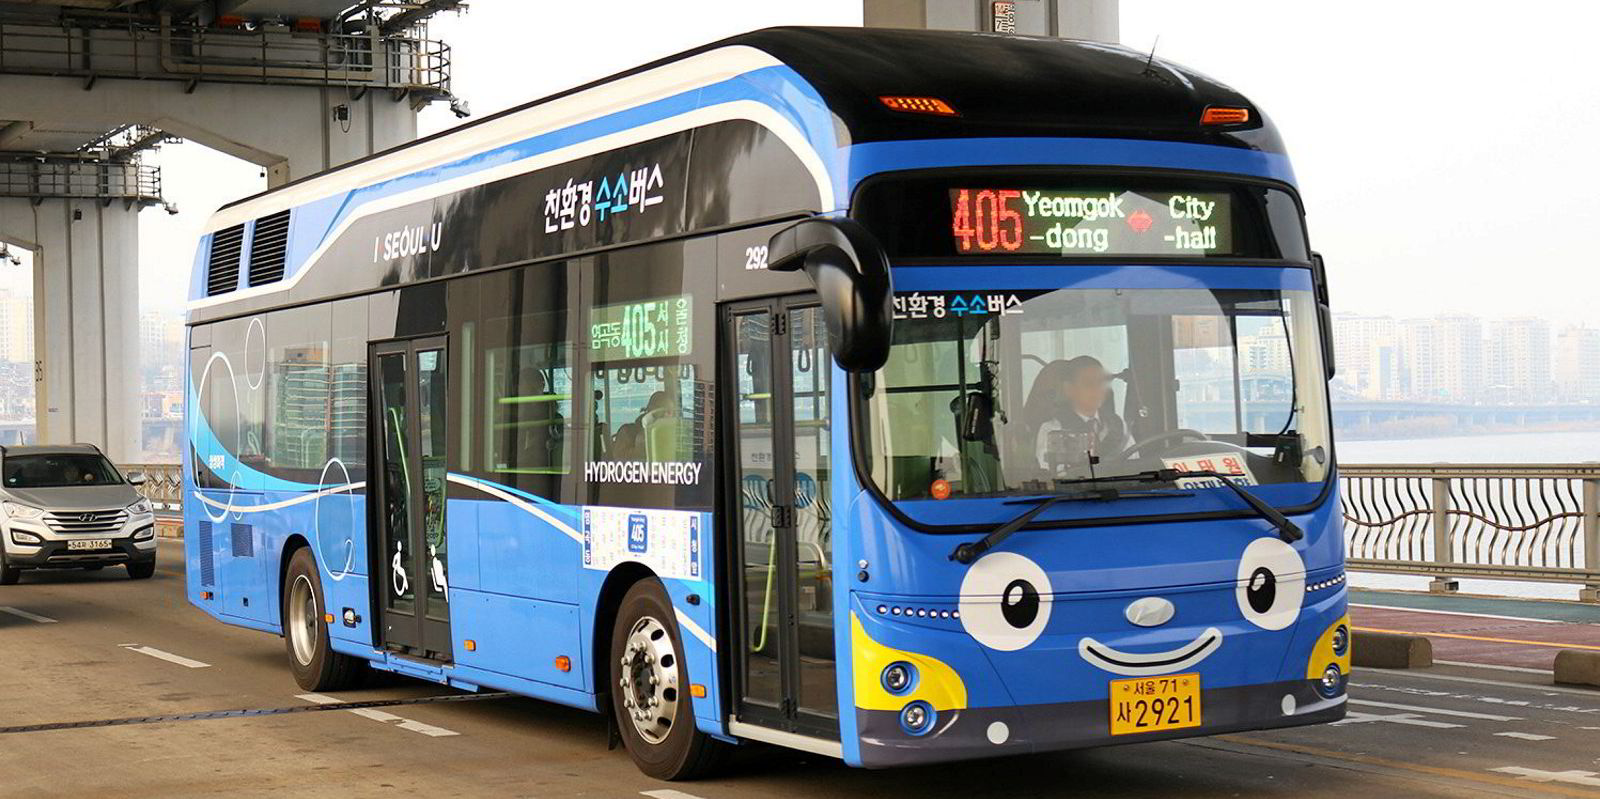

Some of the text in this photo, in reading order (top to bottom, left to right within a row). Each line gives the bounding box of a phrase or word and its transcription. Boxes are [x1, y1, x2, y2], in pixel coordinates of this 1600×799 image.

[544, 178, 593, 233] 친환경
[953, 189, 1024, 251] 405
[1021, 190, 1125, 221] Yeomgok
[1168, 195, 1215, 220] City
[383, 225, 427, 261] SEOUL
[431, 222, 442, 251] U
[1029, 223, 1109, 252] -dong
[892, 292, 946, 319] 친환경
[621, 302, 656, 358] 405
[584, 461, 702, 485] HYDROGEN ENERGY
[631, 524, 645, 543] 405
[1134, 679, 1177, 695] 서울 71
[1117, 695, 1193, 728] 사 2921
